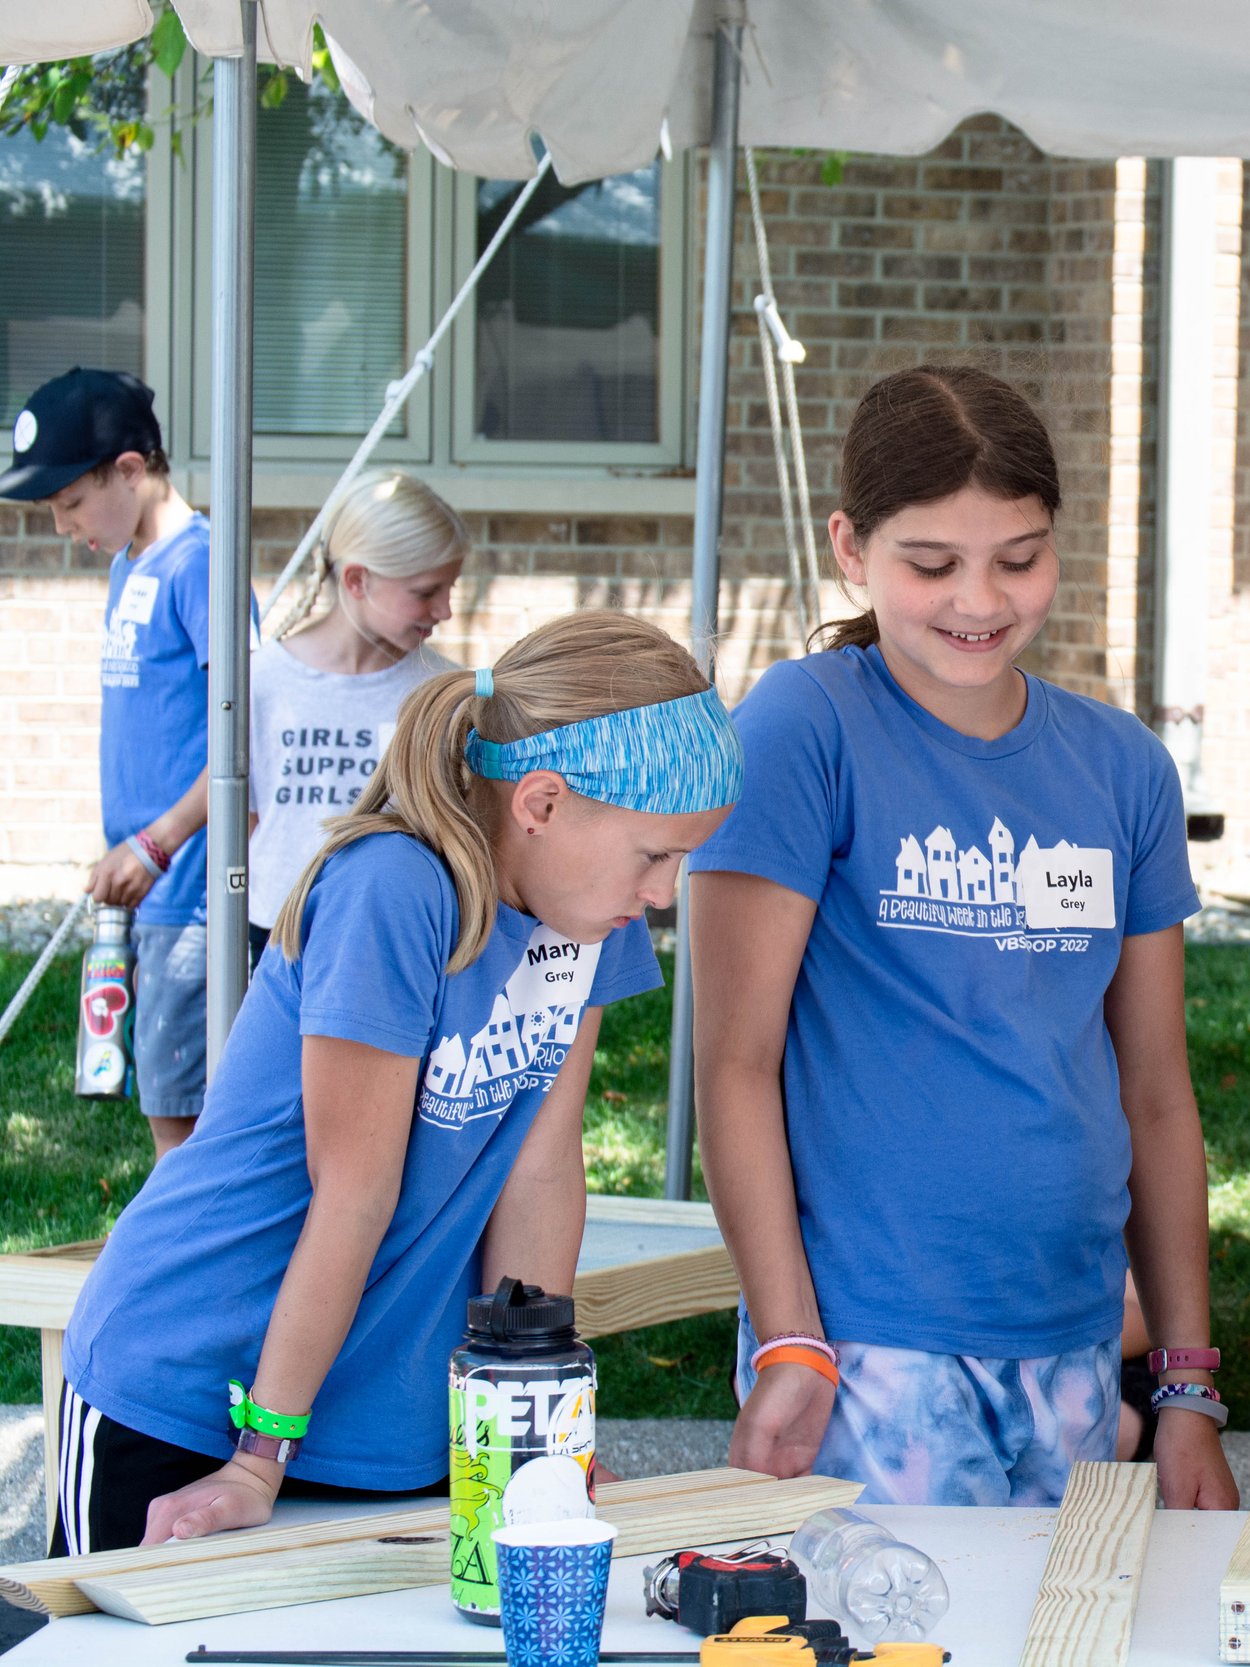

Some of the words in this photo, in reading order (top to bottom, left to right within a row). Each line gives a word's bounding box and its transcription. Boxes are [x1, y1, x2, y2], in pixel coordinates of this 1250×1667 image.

[281, 728, 373, 748] GIRLS
[281, 757, 378, 777] SUPPO
[275, 785, 363, 805] GIRLS
[1045, 869, 1093, 893] Layla
[878, 898, 889, 921] A
[976, 908, 989, 929] in
[1060, 898, 1086, 912] Grey
[994, 936, 1026, 952] VBS
[1059, 938, 1089, 952] 2022
[526, 942, 581, 967] Mary
[544, 970, 575, 983] Grey
